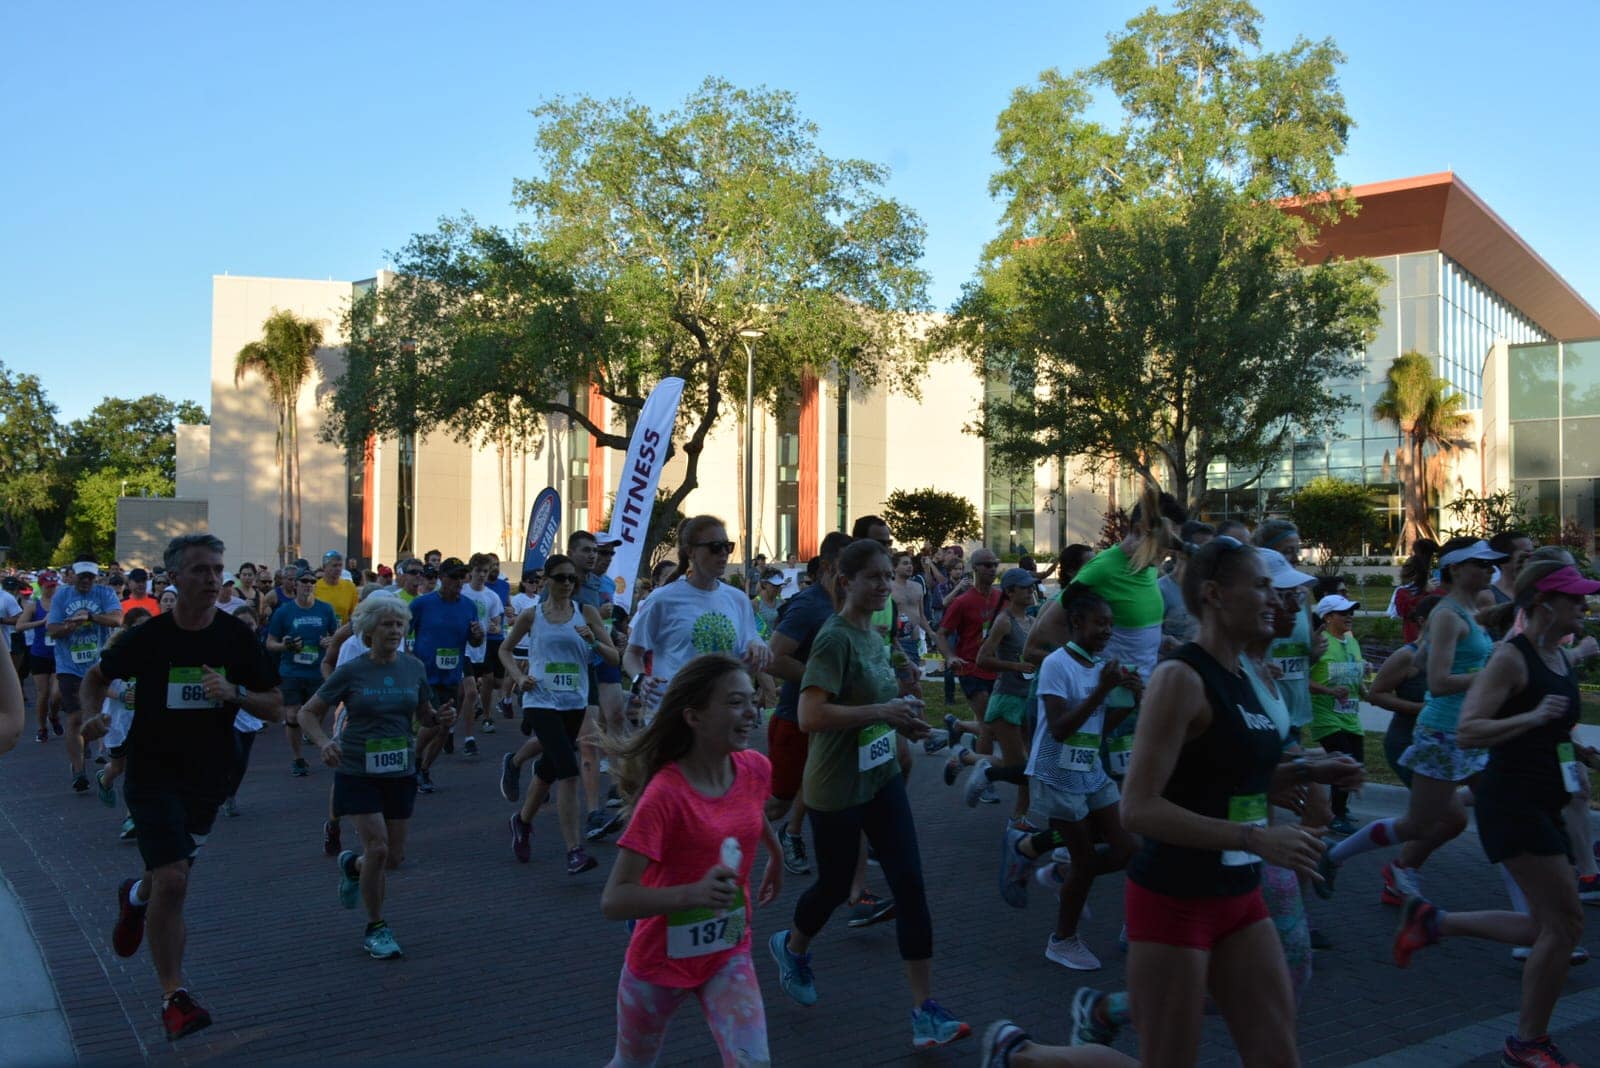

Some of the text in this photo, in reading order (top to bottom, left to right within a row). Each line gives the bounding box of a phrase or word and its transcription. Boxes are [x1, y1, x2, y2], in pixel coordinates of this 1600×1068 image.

[621, 428, 660, 544] FITNESS
[539, 515, 558, 557] START
[553, 674, 572, 687] 415
[373, 751, 404, 768] 1093
[870, 737, 890, 761] 689
[688, 917, 729, 946] 137
